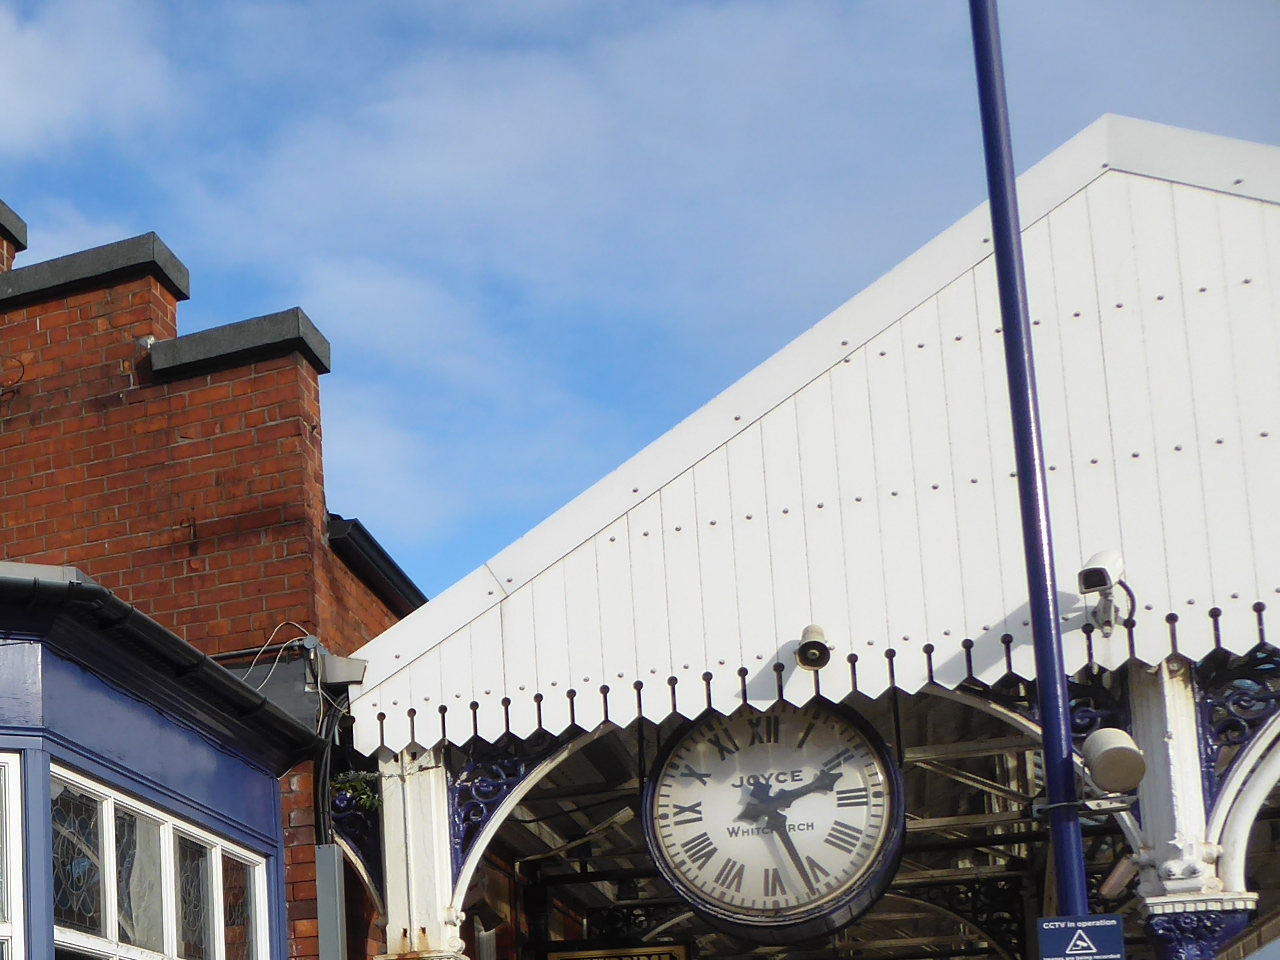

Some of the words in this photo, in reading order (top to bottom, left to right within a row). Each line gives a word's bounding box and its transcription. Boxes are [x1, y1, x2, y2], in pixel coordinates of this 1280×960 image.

[730, 769, 804, 789] JOYCE
[1042, 921, 1066, 929] CCTV
[1076, 919, 1117, 928] operation
